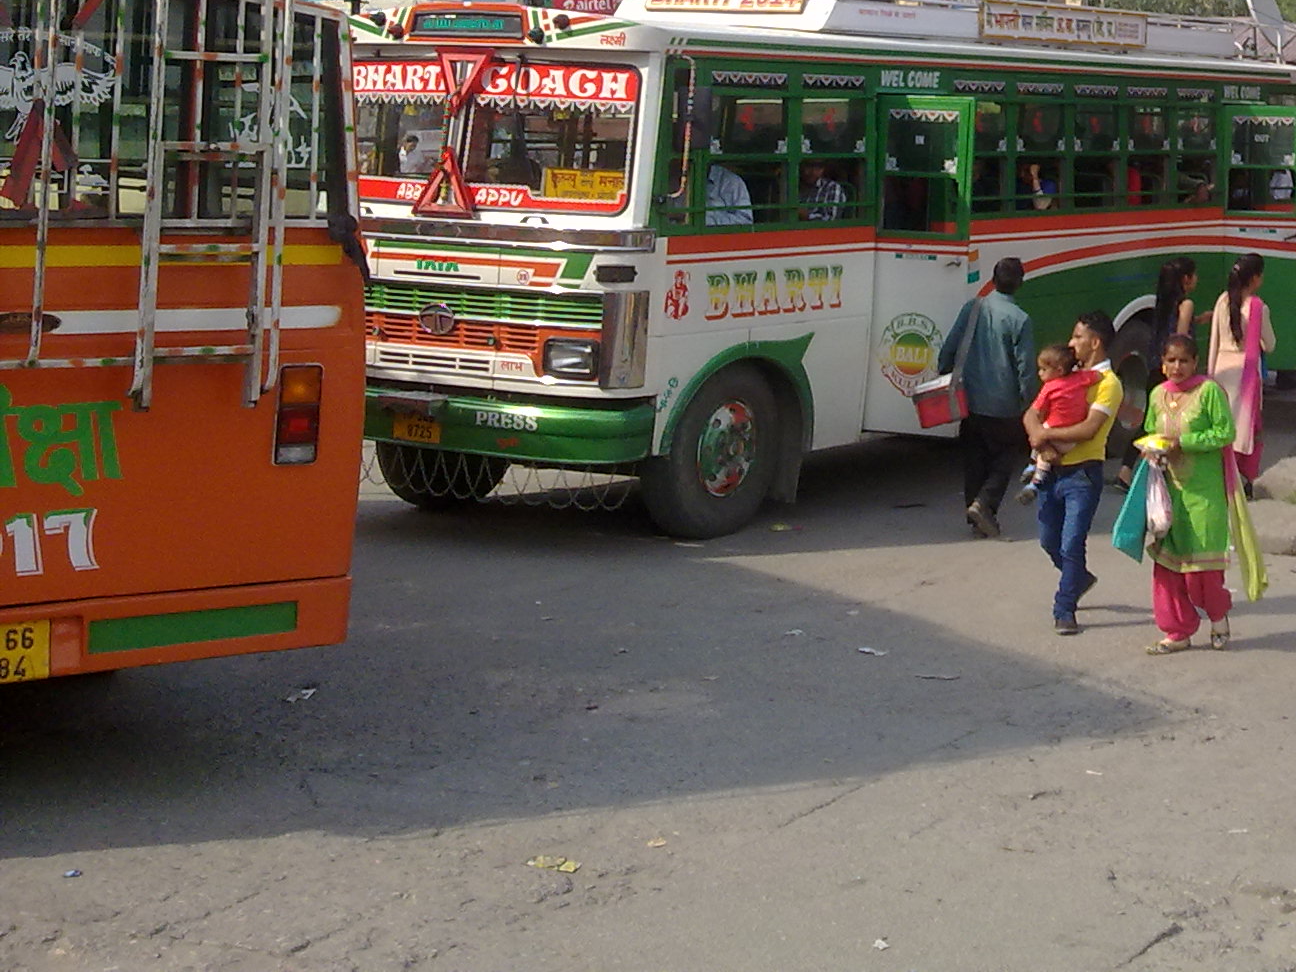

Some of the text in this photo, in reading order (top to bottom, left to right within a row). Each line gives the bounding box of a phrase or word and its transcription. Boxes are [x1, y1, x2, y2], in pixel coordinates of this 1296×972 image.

[481, 65, 630, 99] COACH
[880, 70, 941, 89] WEL COME
[1254, 133, 1269, 143] OUT
[475, 188, 525, 207] APPU
[704, 264, 844, 321] BHARTI
[500, 360, 525, 372] लाभ
[474, 410, 539, 432] PRESS
[0, 508, 100, 577] 17
[5, 627, 35, 651] 66
